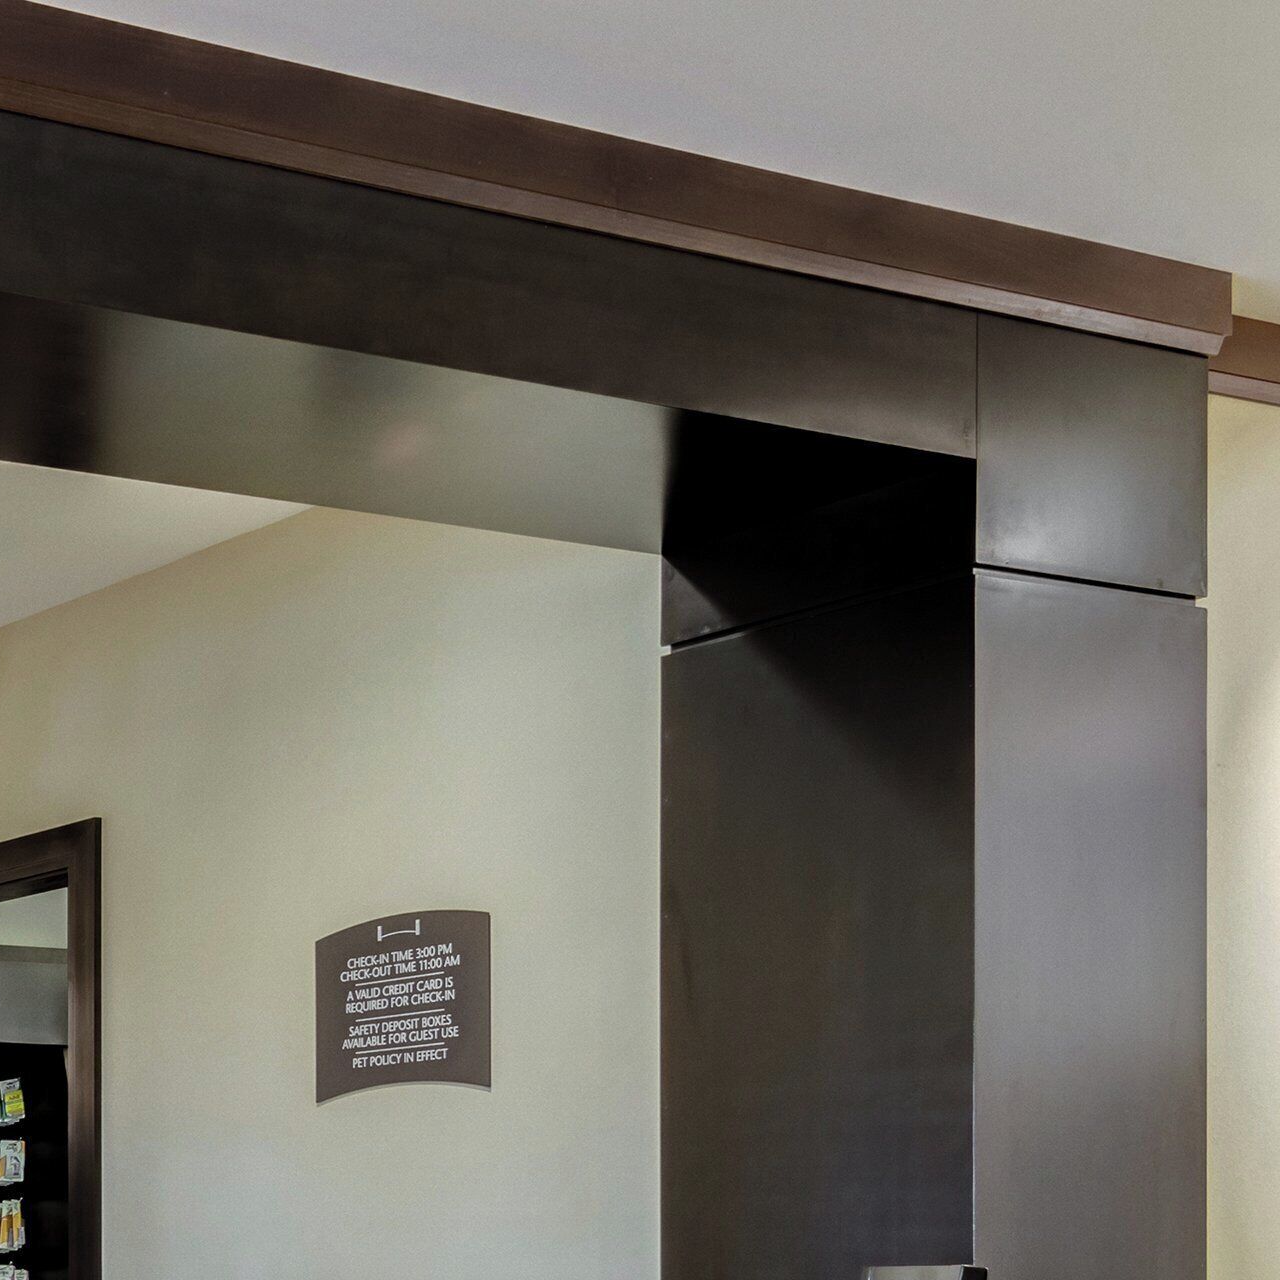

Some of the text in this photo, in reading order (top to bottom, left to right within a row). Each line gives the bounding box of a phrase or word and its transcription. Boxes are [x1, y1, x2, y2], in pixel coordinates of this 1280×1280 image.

[340, 954, 460, 982] CHECK-OUT TIME 11:00 AM
[347, 943, 452, 969] CHECK-IN TIME 3:00 PM
[347, 977, 453, 1001] A VALID CREDIT CARD IS
[345, 989, 456, 1014] REQUIRED FOR CHECK-IN
[349, 1014, 452, 1037] SAFETY DEPOSIT BOXES
[342, 1026, 459, 1050] AVAILABLE FOR GUEST USE
[352, 1048, 448, 1068] PET POLICY IN EFFECT
